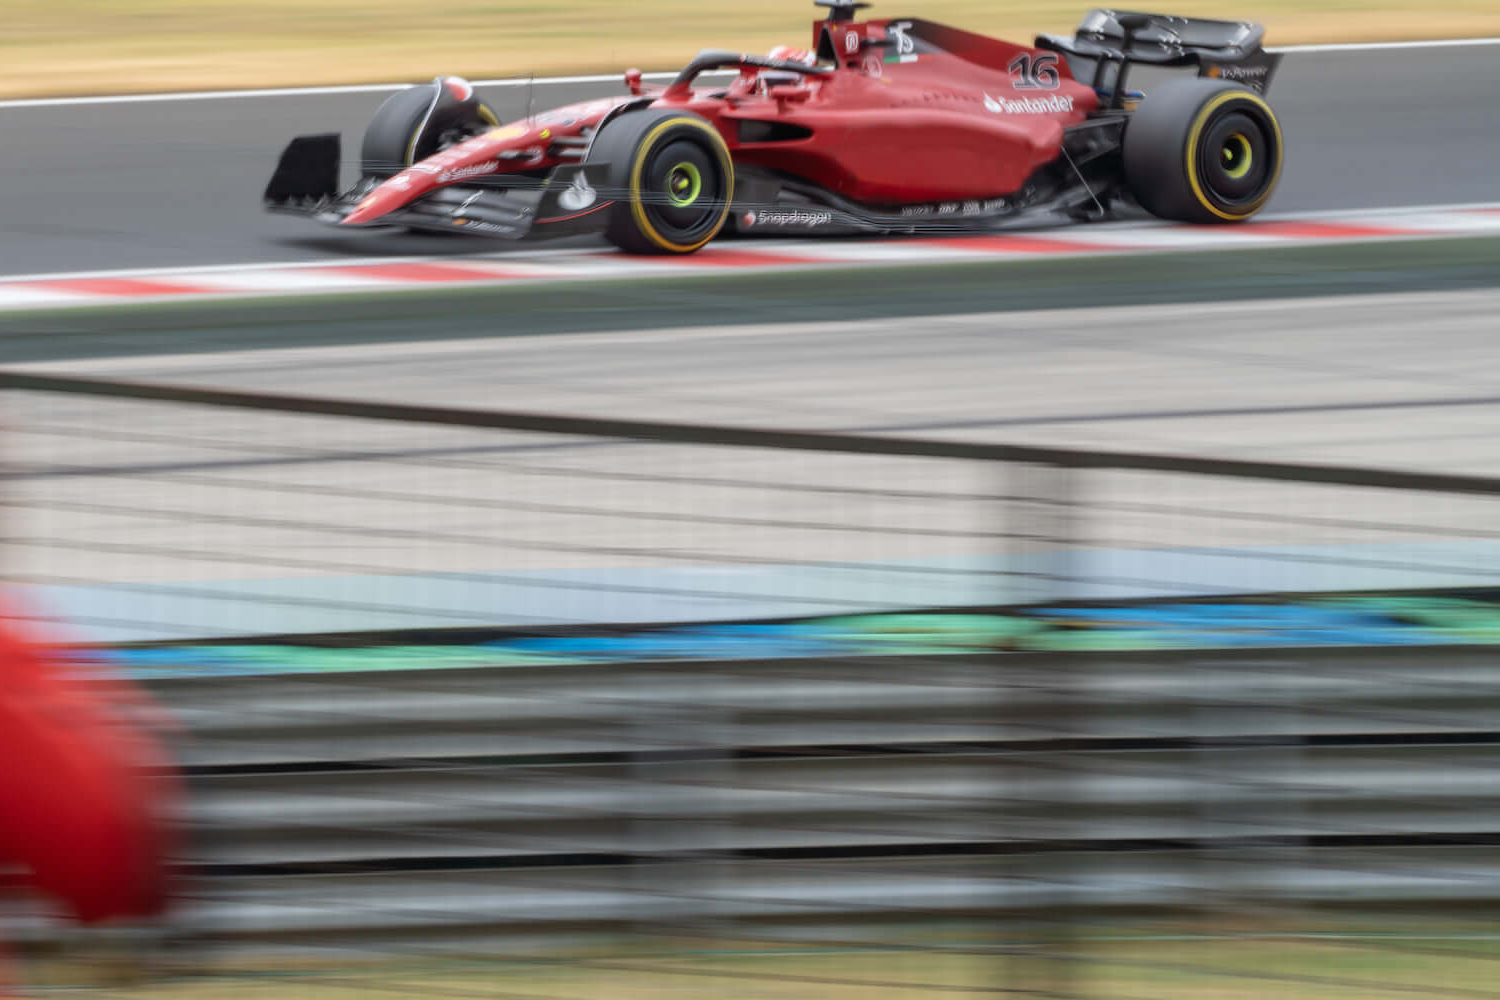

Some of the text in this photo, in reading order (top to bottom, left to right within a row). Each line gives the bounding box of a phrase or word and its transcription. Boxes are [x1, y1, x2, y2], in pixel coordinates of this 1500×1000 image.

[1008, 52, 1061, 91] 16
[998, 93, 1074, 114] Santander
[758, 209, 832, 228] Snapdragon
